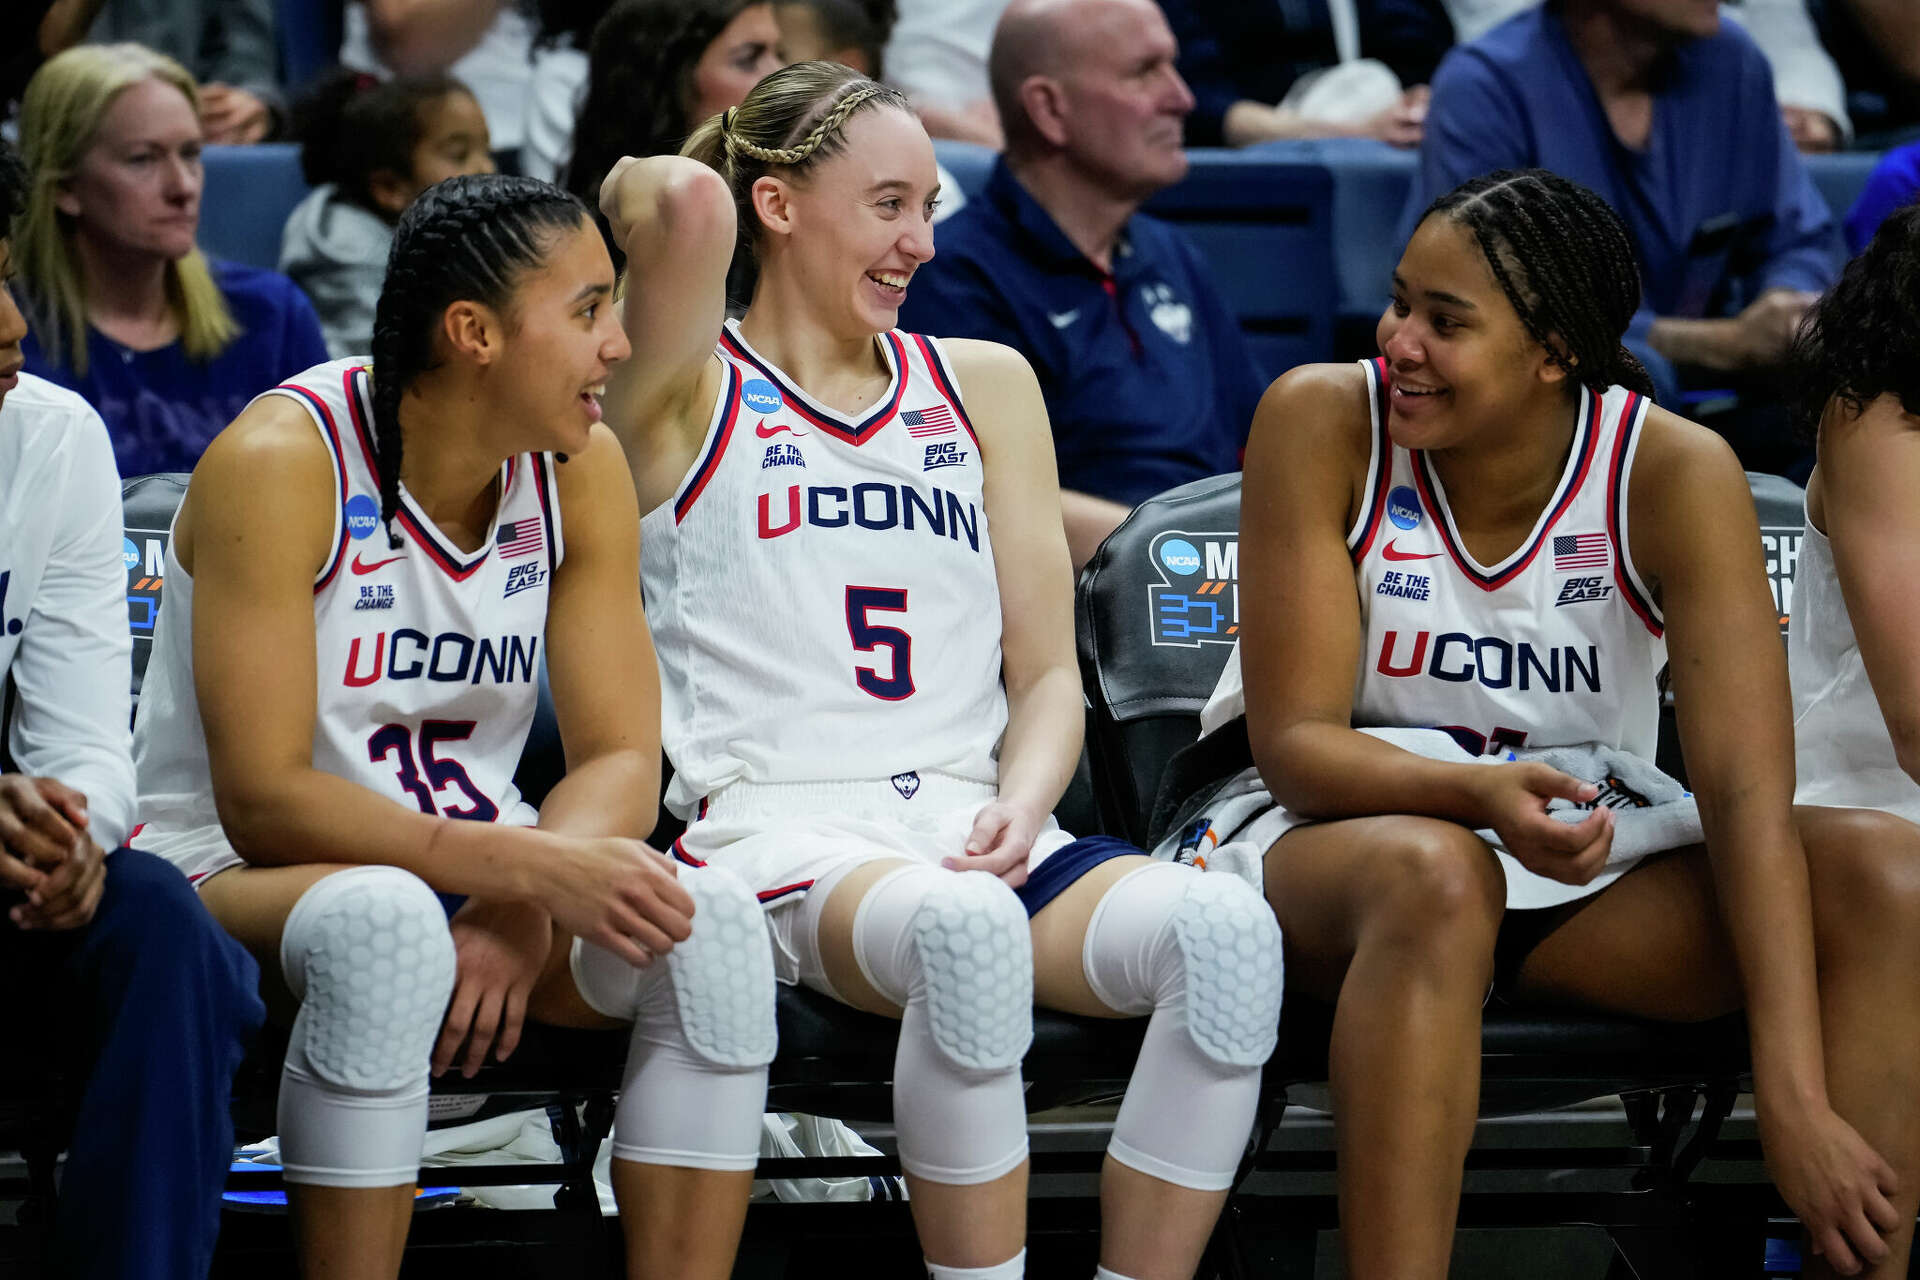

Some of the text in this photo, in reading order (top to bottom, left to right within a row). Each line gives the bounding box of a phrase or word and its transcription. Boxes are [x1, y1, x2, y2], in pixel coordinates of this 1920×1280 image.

[747, 393, 780, 406] NCAA
[765, 444, 782, 458] BE
[925, 442, 957, 455] BIG
[924, 452, 968, 467] EAST
[757, 482, 980, 553] UCONN
[1391, 503, 1420, 522] NCAA
[348, 516, 377, 528] NCAA
[1166, 556, 1200, 567] NCAA
[509, 561, 539, 579] BIG
[505, 570, 548, 592] EAST
[1384, 571, 1430, 588] BE THE
[1563, 576, 1604, 590] BIG
[360, 585, 394, 598] BE THE
[1376, 582, 1430, 601] CHANGE
[1557, 586, 1613, 600] EAST
[354, 597, 395, 611] CHANGE
[845, 585, 916, 700] 5
[342, 628, 537, 687] UCONN
[1376, 631, 1602, 692] UCONN
[368, 720, 499, 822] 35
